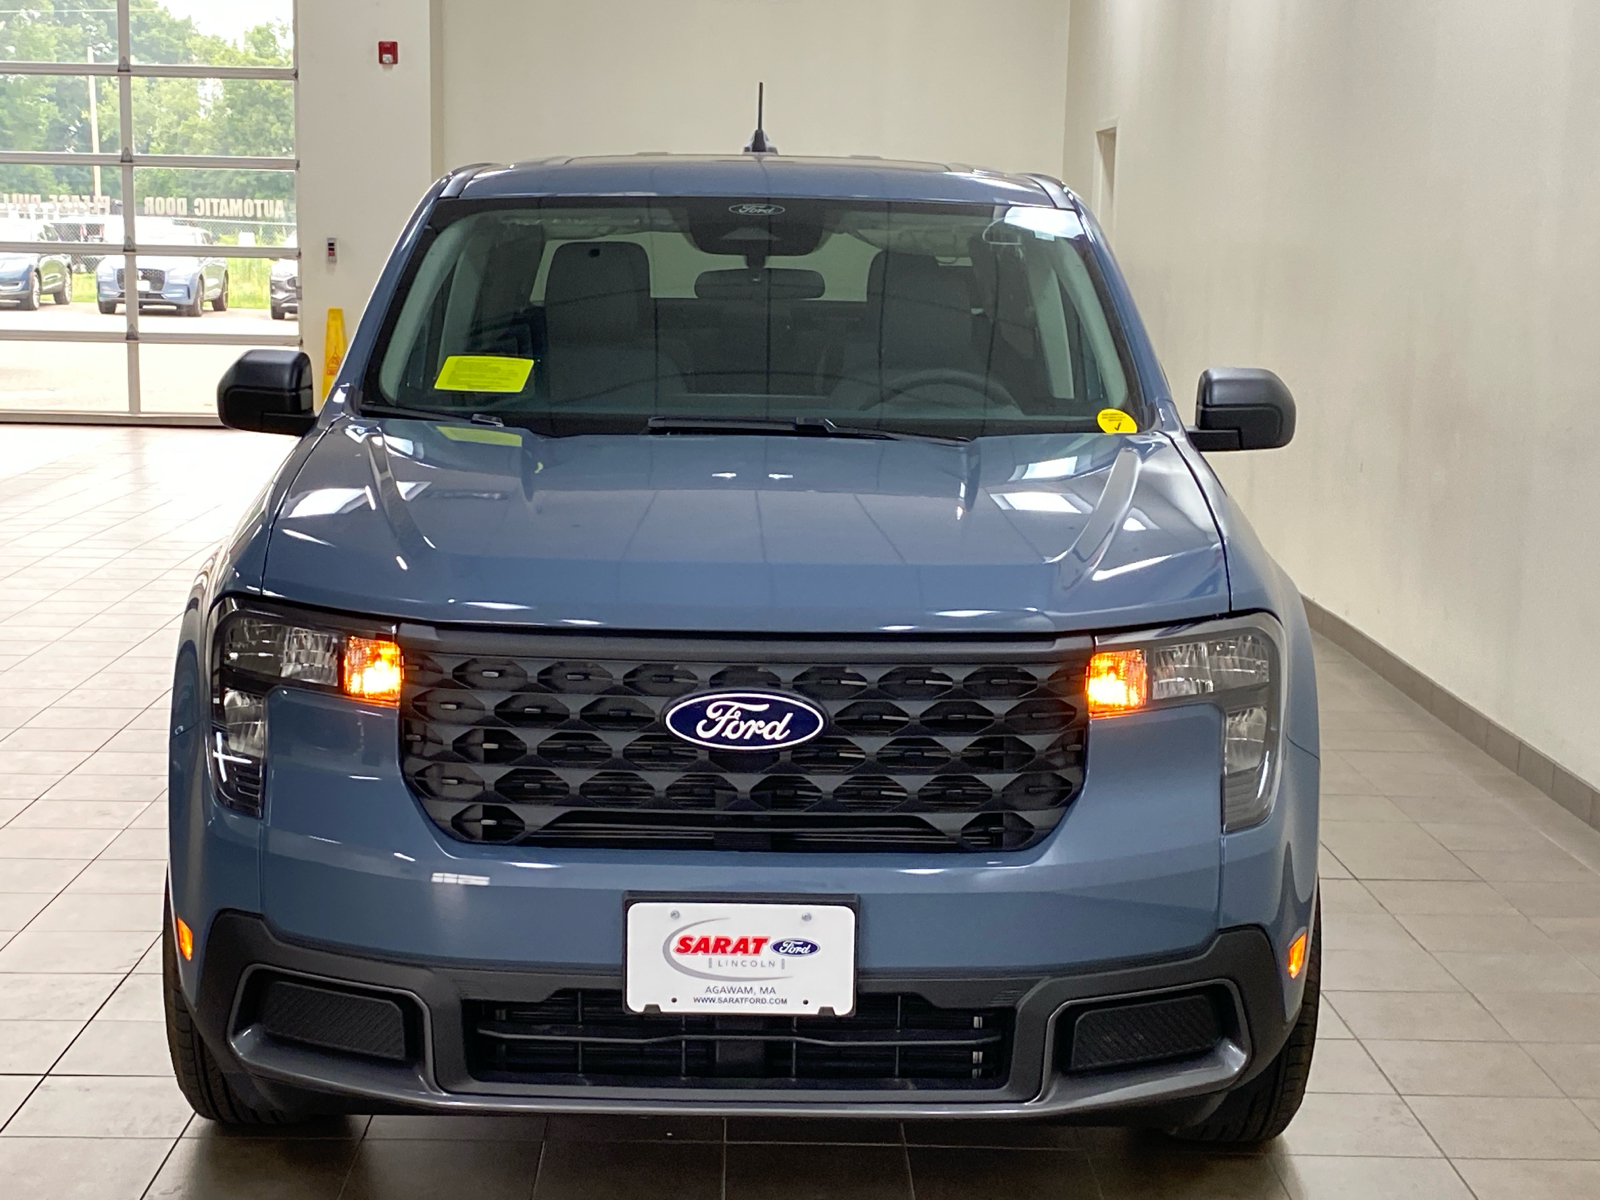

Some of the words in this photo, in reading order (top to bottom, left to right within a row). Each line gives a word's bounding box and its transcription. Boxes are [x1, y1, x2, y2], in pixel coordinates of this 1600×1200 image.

[738, 204, 775, 214] Ford
[696, 700, 794, 741] Ford
[673, 934, 771, 956] SARAT
[778, 940, 812, 955] Ford
[717, 959, 776, 968] LINCOLN
[705, 985, 757, 995] AGAWAM,
[759, 986, 777, 995] MA
[693, 996, 788, 1005] WWW.SARATFORD.COM
